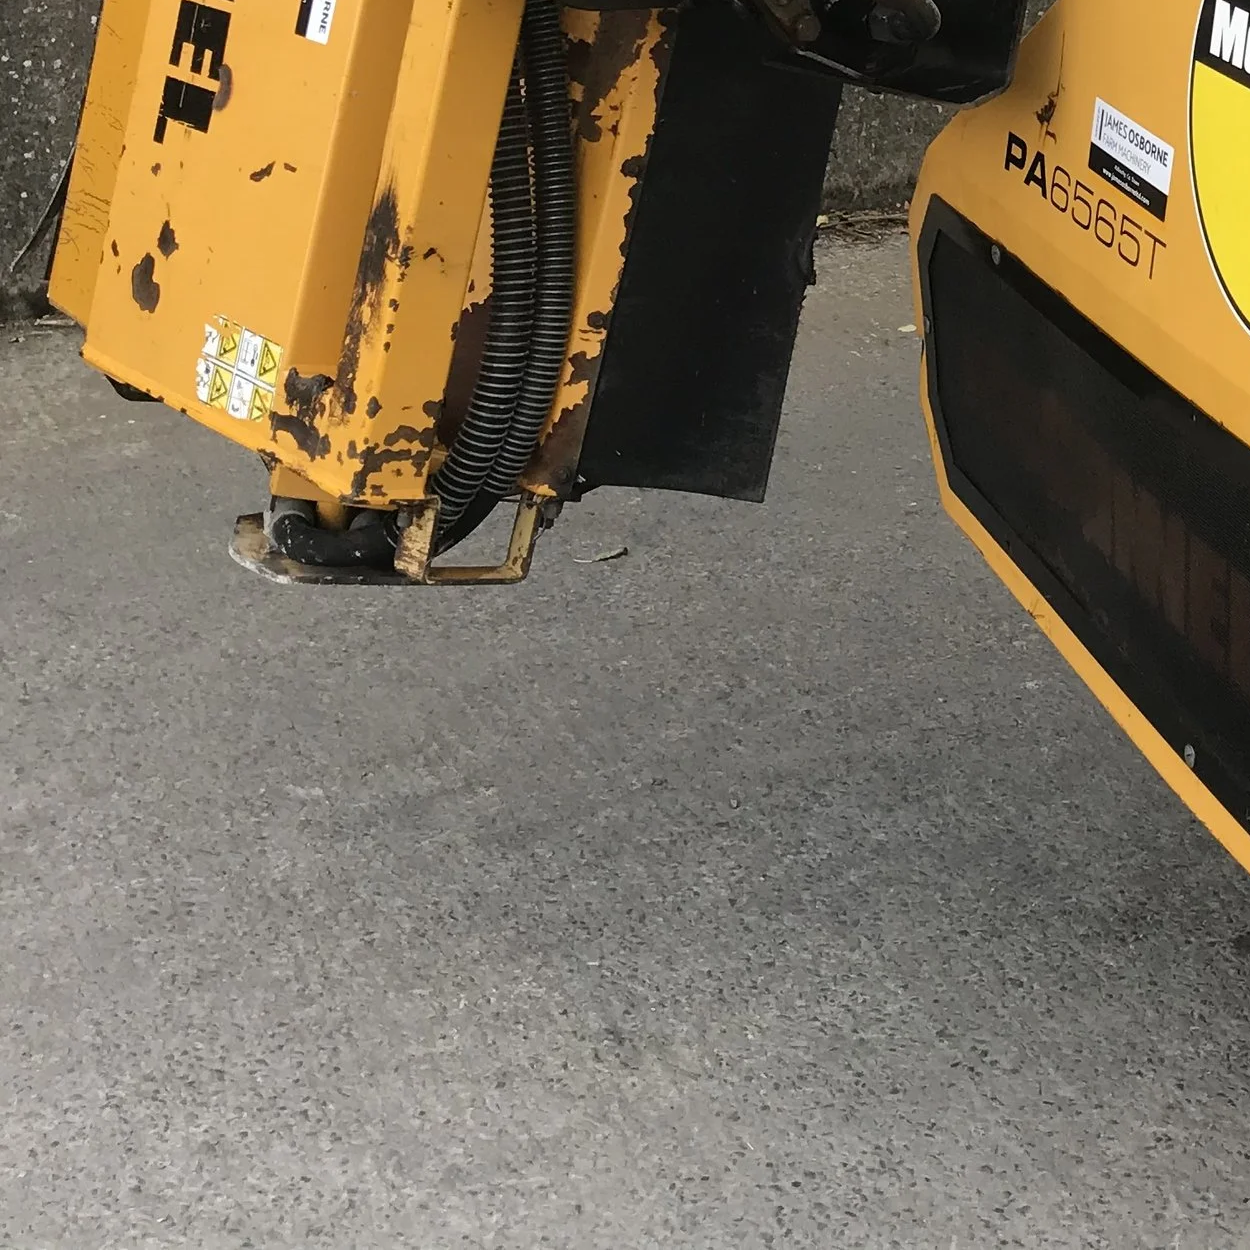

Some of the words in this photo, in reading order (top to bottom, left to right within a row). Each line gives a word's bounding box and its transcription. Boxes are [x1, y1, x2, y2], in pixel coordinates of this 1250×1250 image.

[1102, 132, 1117, 152] FARM
[1118, 142, 1151, 175] MACHINERY
[1104, 111, 1128, 140] JAMES
[1127, 127, 1168, 168] OSBORNE
[1004, 131, 1167, 280] PA6565T
